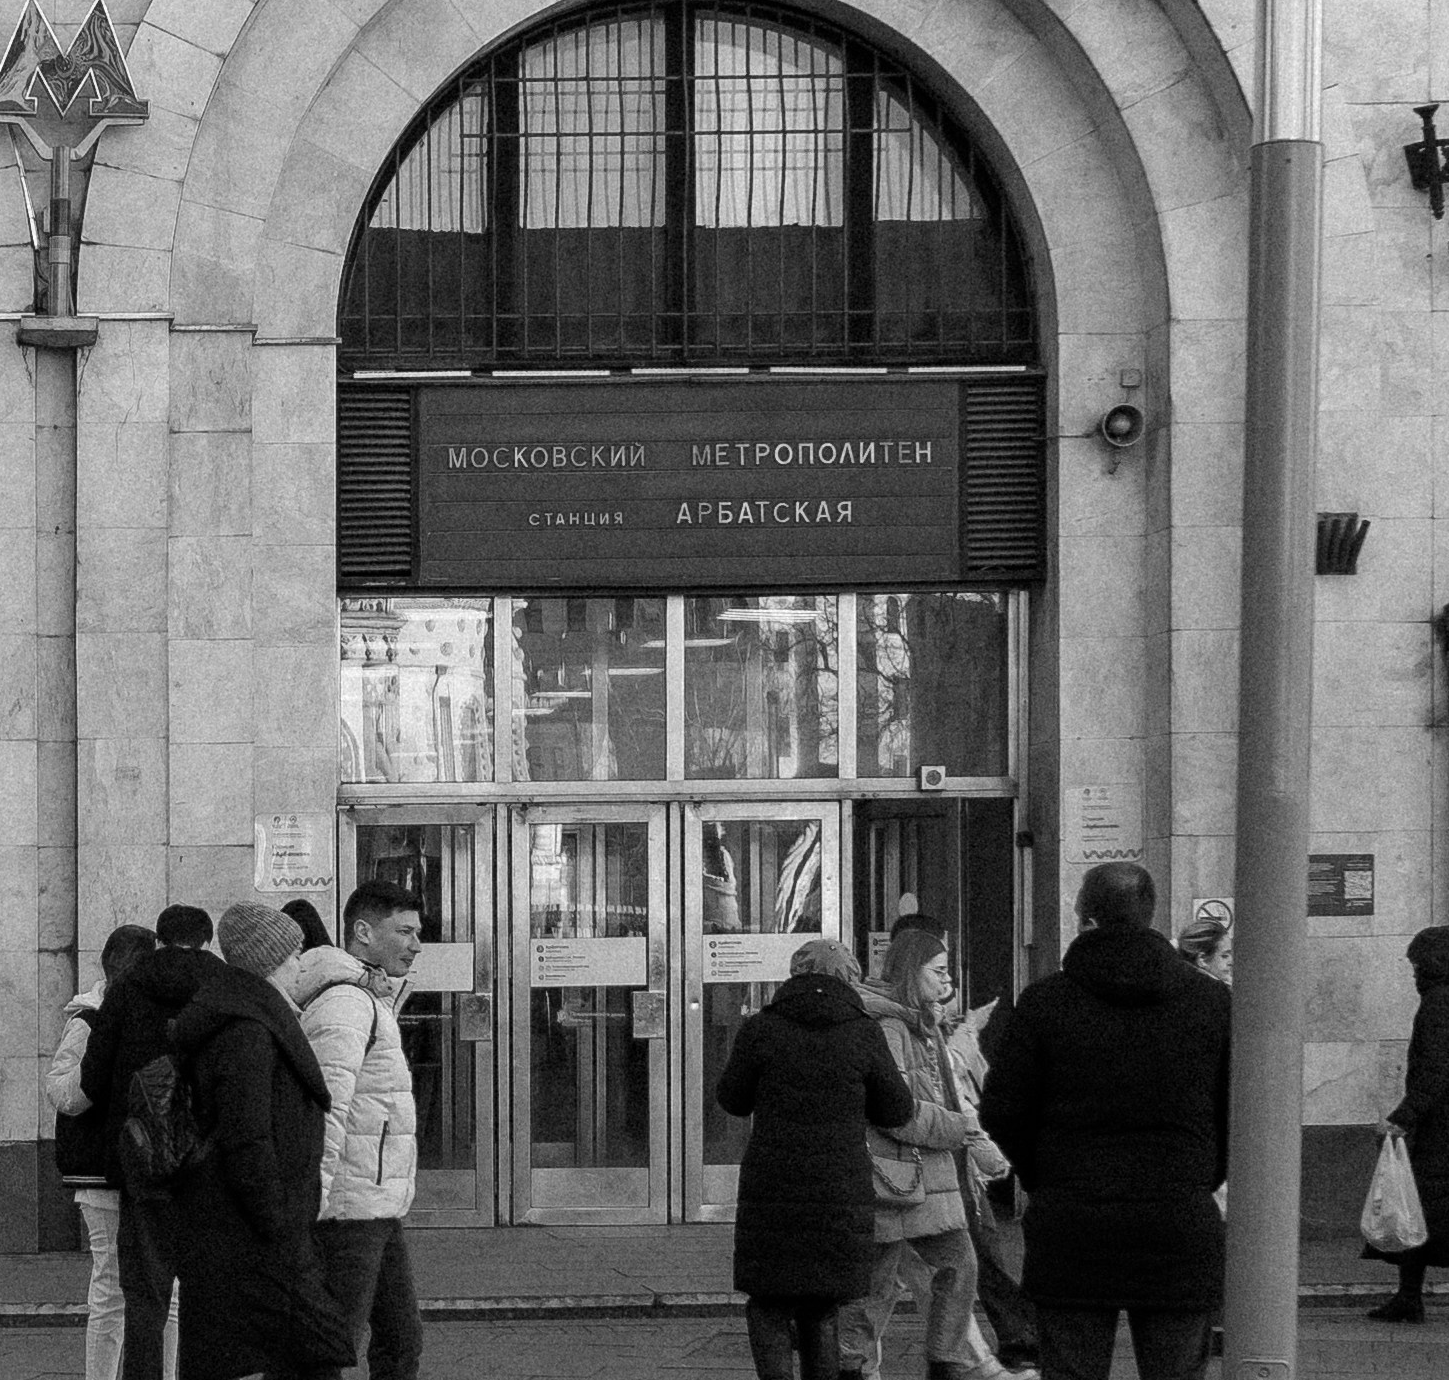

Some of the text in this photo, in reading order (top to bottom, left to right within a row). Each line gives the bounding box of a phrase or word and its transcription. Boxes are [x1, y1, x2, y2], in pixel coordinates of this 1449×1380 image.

[447, 441, 932, 470] МОСКОВСКИЙ МЕТРОПОЛИТЕН
[528, 500, 853, 528] СТАНЦИЯ АРБАТСКАЯ
